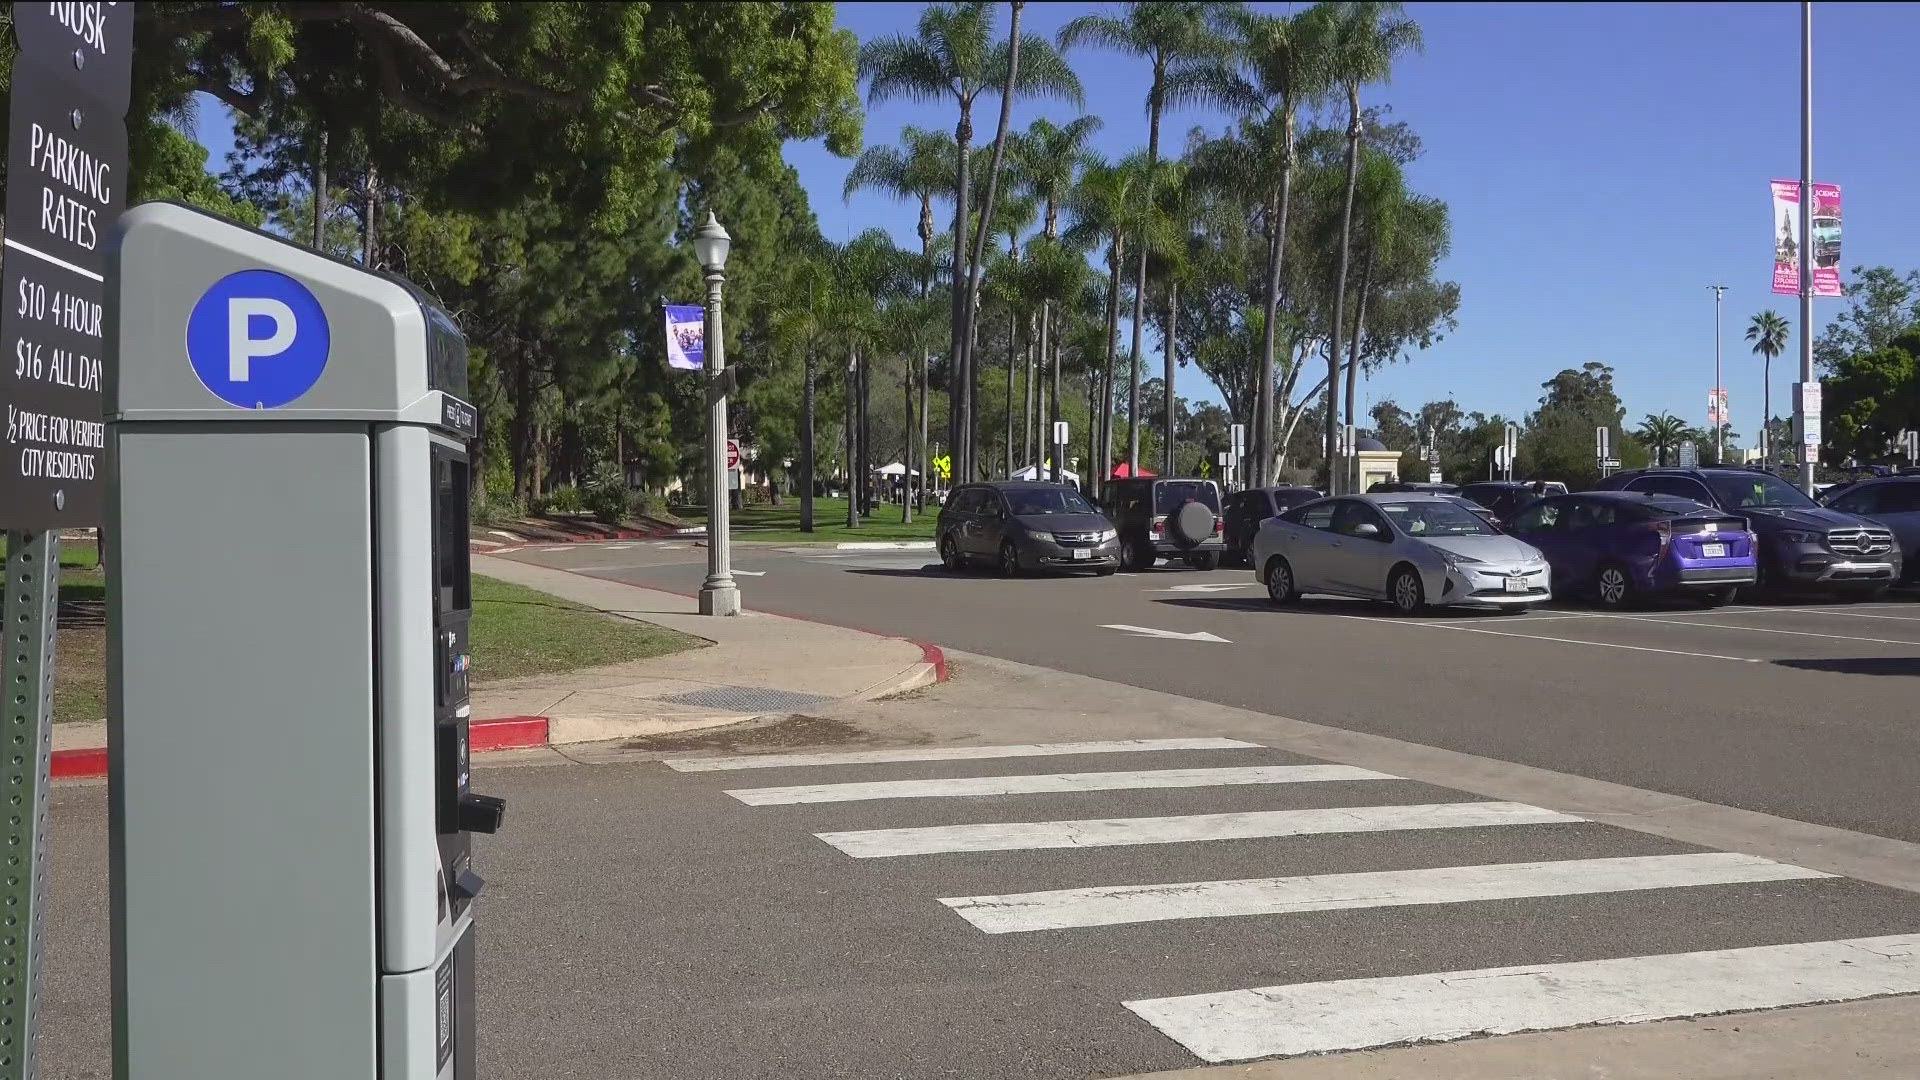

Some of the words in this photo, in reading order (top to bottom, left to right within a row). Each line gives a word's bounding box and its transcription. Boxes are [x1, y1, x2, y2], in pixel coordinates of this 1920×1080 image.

[30, 123, 110, 204] PARKING
[1814, 189, 1840, 198] SCIENCE
[41, 187, 97, 251] RATES
[18, 276, 45, 320] $10
[51, 291, 61, 325] 4
[16, 337, 42, 380] $16
[49, 348, 75, 387] ALL
[228, 298, 298, 382] P
[19, 411, 47, 442] PRICE
[50, 416, 69, 445] FOR
[70, 419, 104, 449] VERIFIE
[21, 448, 45, 477] CITY
[46, 450, 95, 480] RESIDENTS
